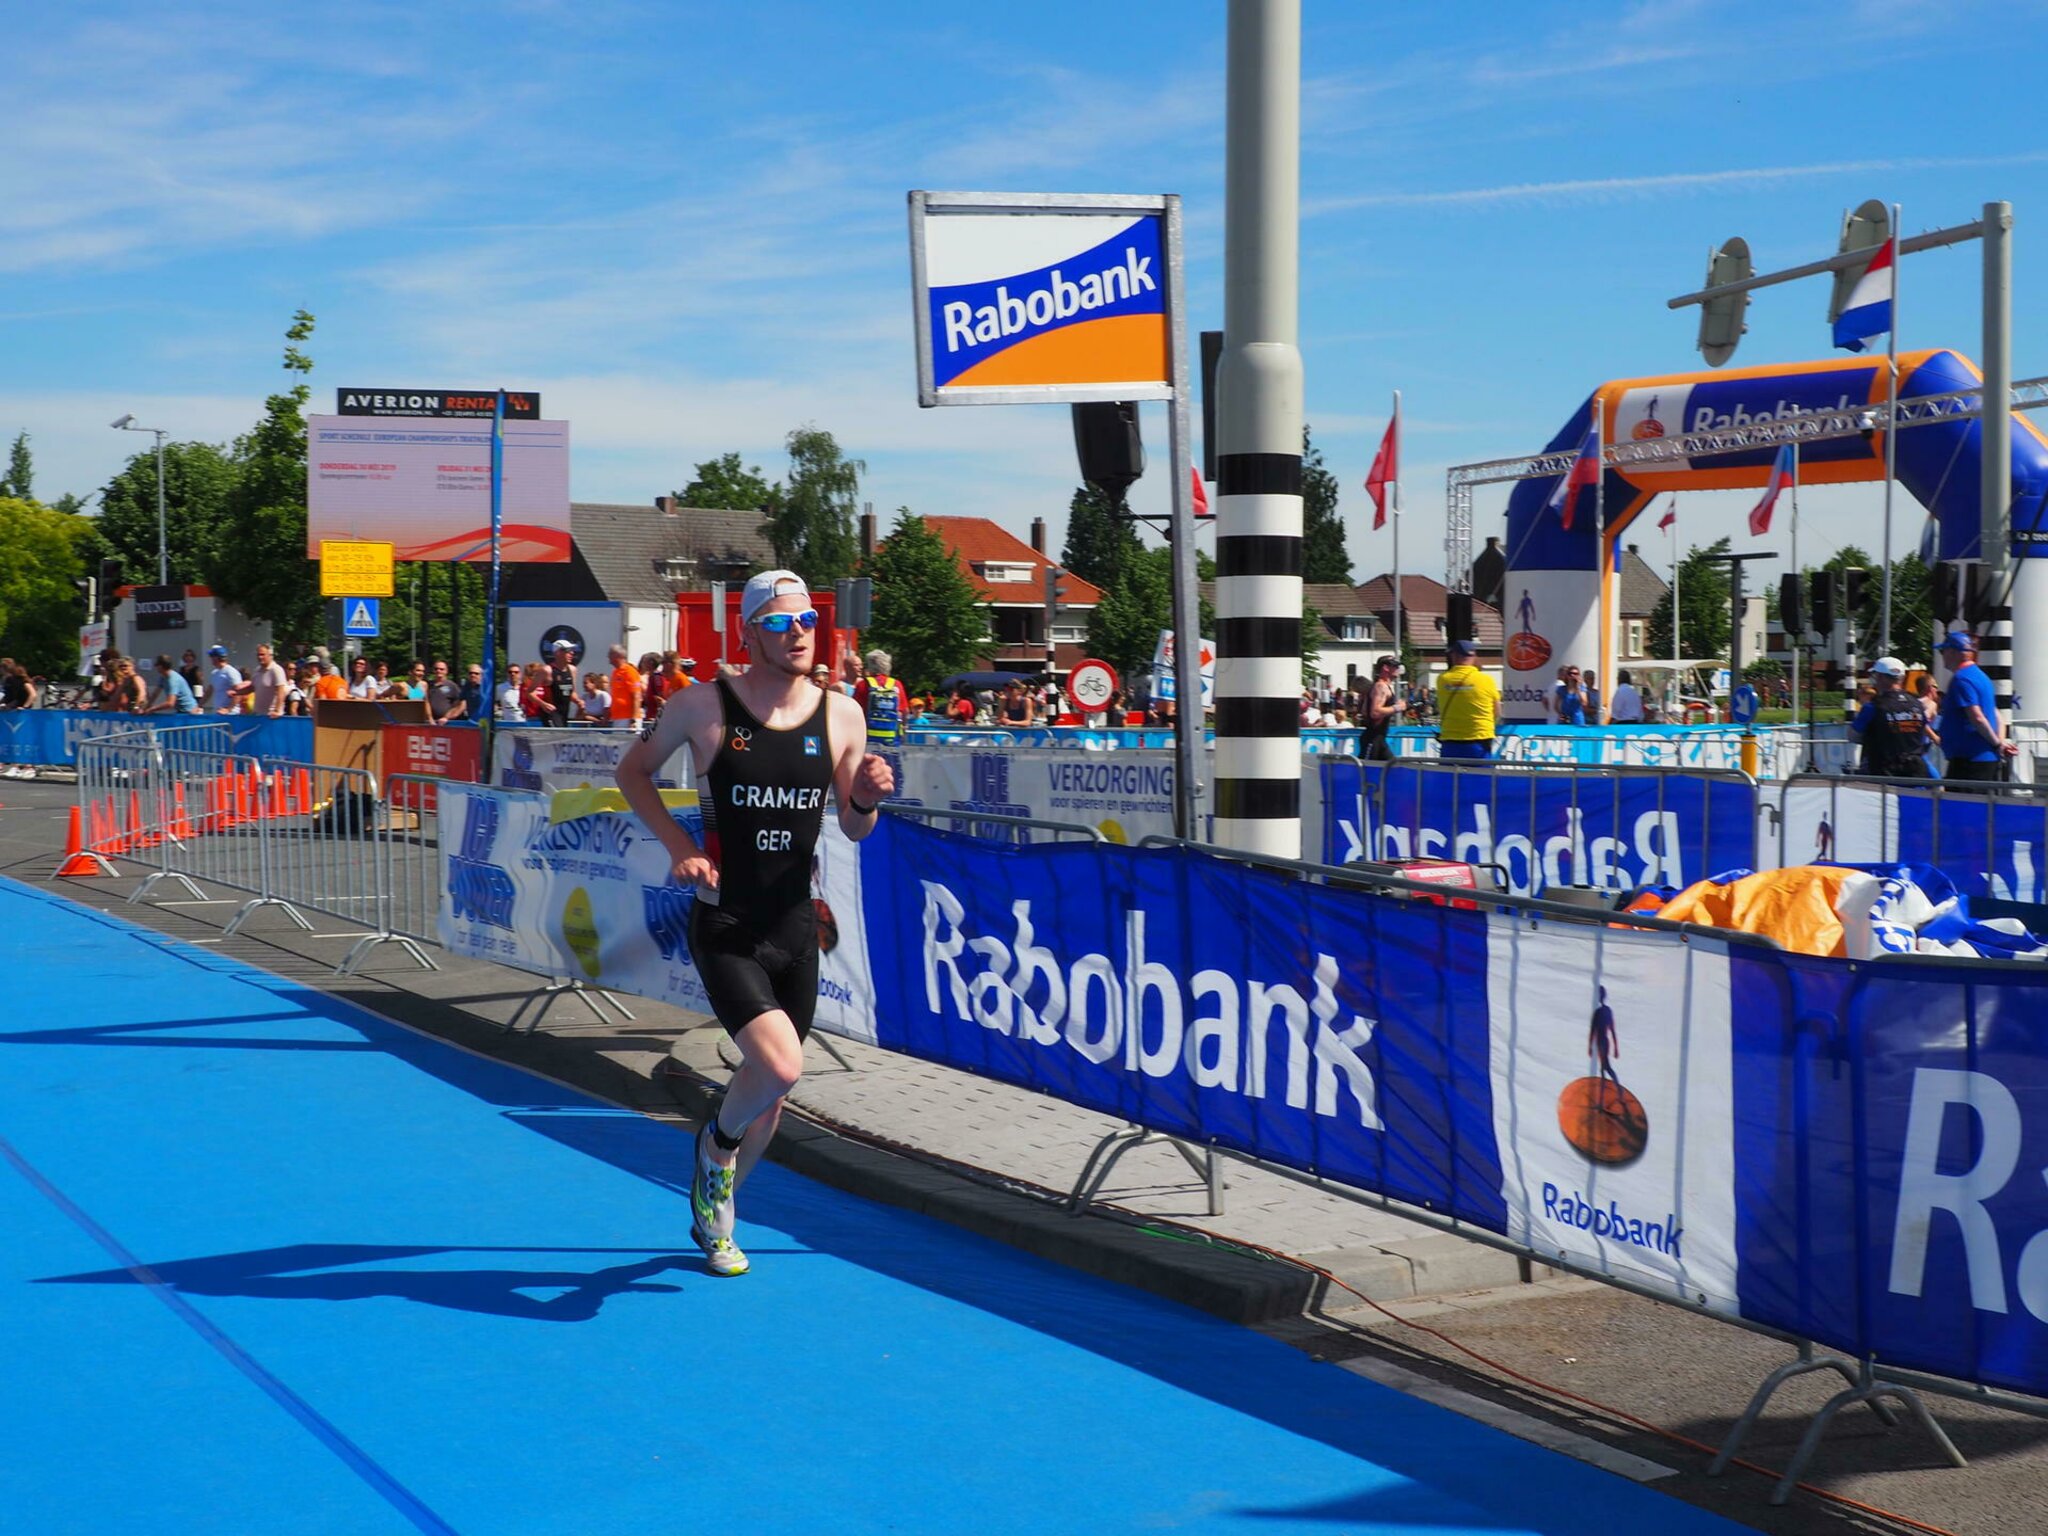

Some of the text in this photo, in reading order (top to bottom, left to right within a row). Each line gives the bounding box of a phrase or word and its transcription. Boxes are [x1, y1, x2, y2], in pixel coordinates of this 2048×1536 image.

[943, 247, 1156, 353] Rabobank
[344, 394, 496, 410] AVERION RENTA
[459, 435, 492, 443] TRIATHLO
[1049, 763, 1174, 797] VERZORGING
[732, 784, 821, 810] CRAMER
[1050, 798, 1070, 808] voor
[1071, 798, 1105, 812] spieren
[1120, 799, 1174, 814] gewrichten
[756, 829, 792, 851] GER
[919, 879, 1386, 1131] Rabobank
[1888, 1067, 2048, 1324] R
[1542, 1182, 1684, 1258] Rabobank
